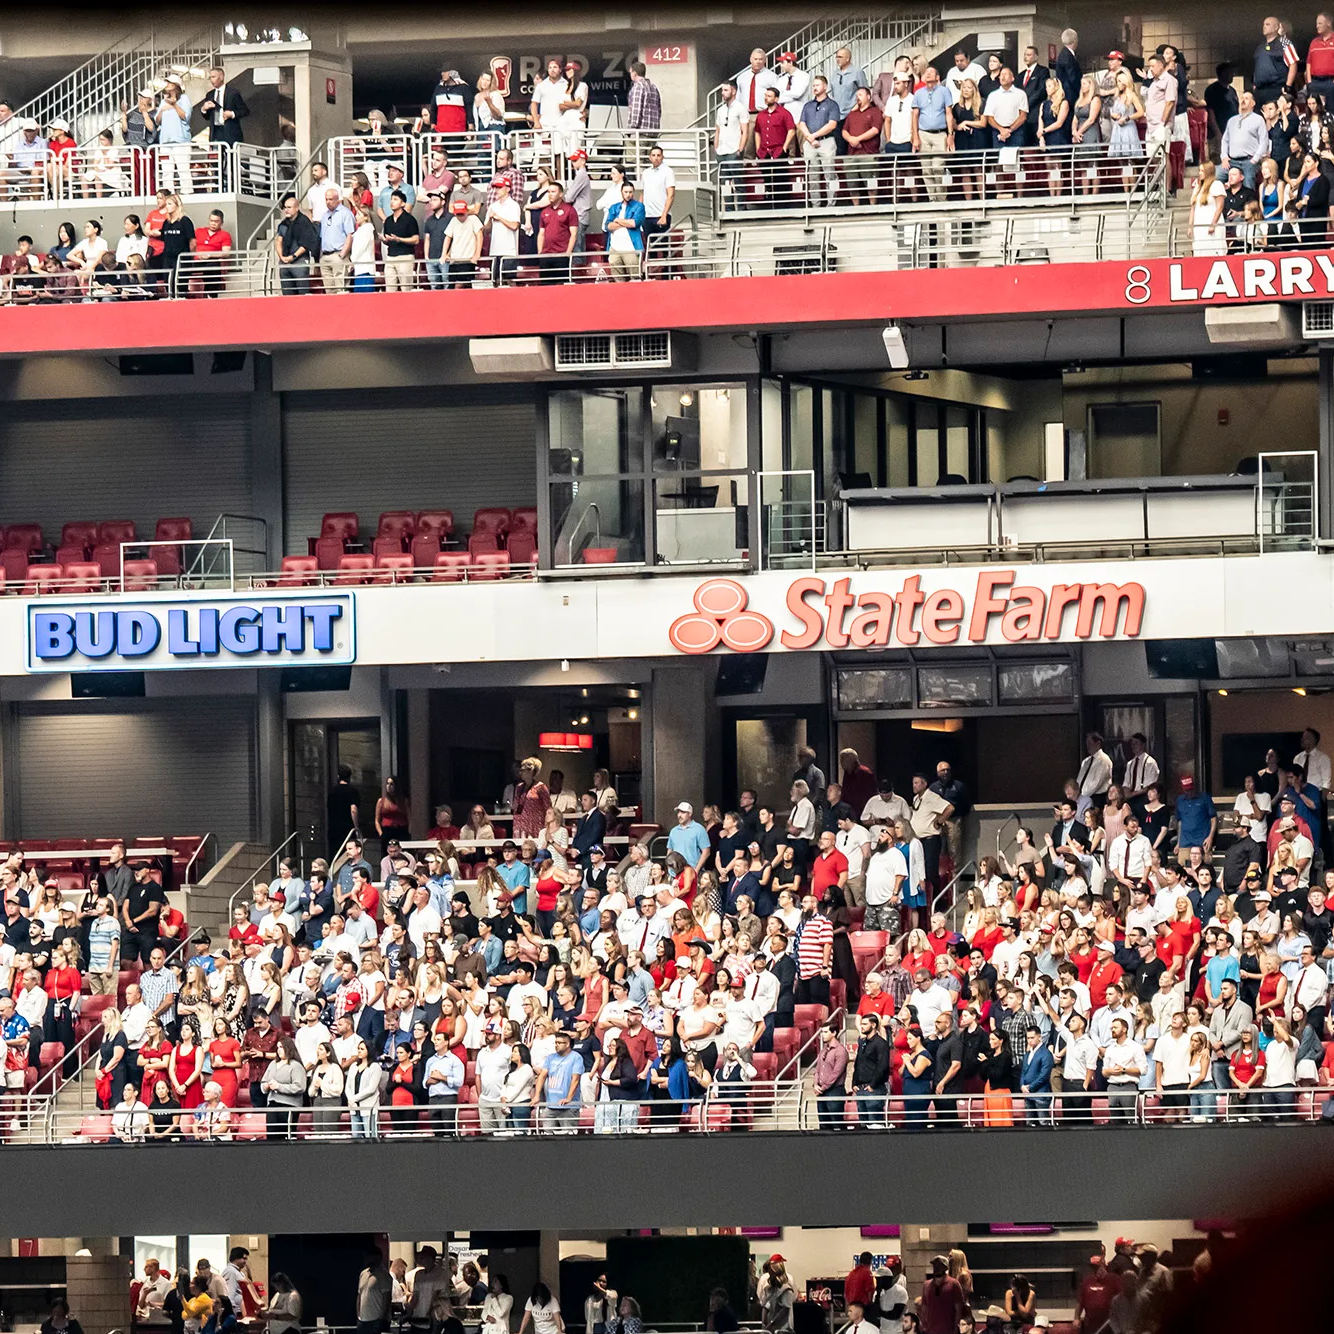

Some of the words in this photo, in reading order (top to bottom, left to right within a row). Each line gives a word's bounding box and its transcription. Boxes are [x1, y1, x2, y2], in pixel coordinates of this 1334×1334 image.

[653, 46, 681, 61] 412
[591, 81, 619, 91] WINE
[1124, 265, 1151, 305] 8
[781, 574, 965, 650] State
[968, 569, 1147, 643] Farm
[34, 612, 162, 660] BUD
[167, 604, 344, 656] LIGHT
